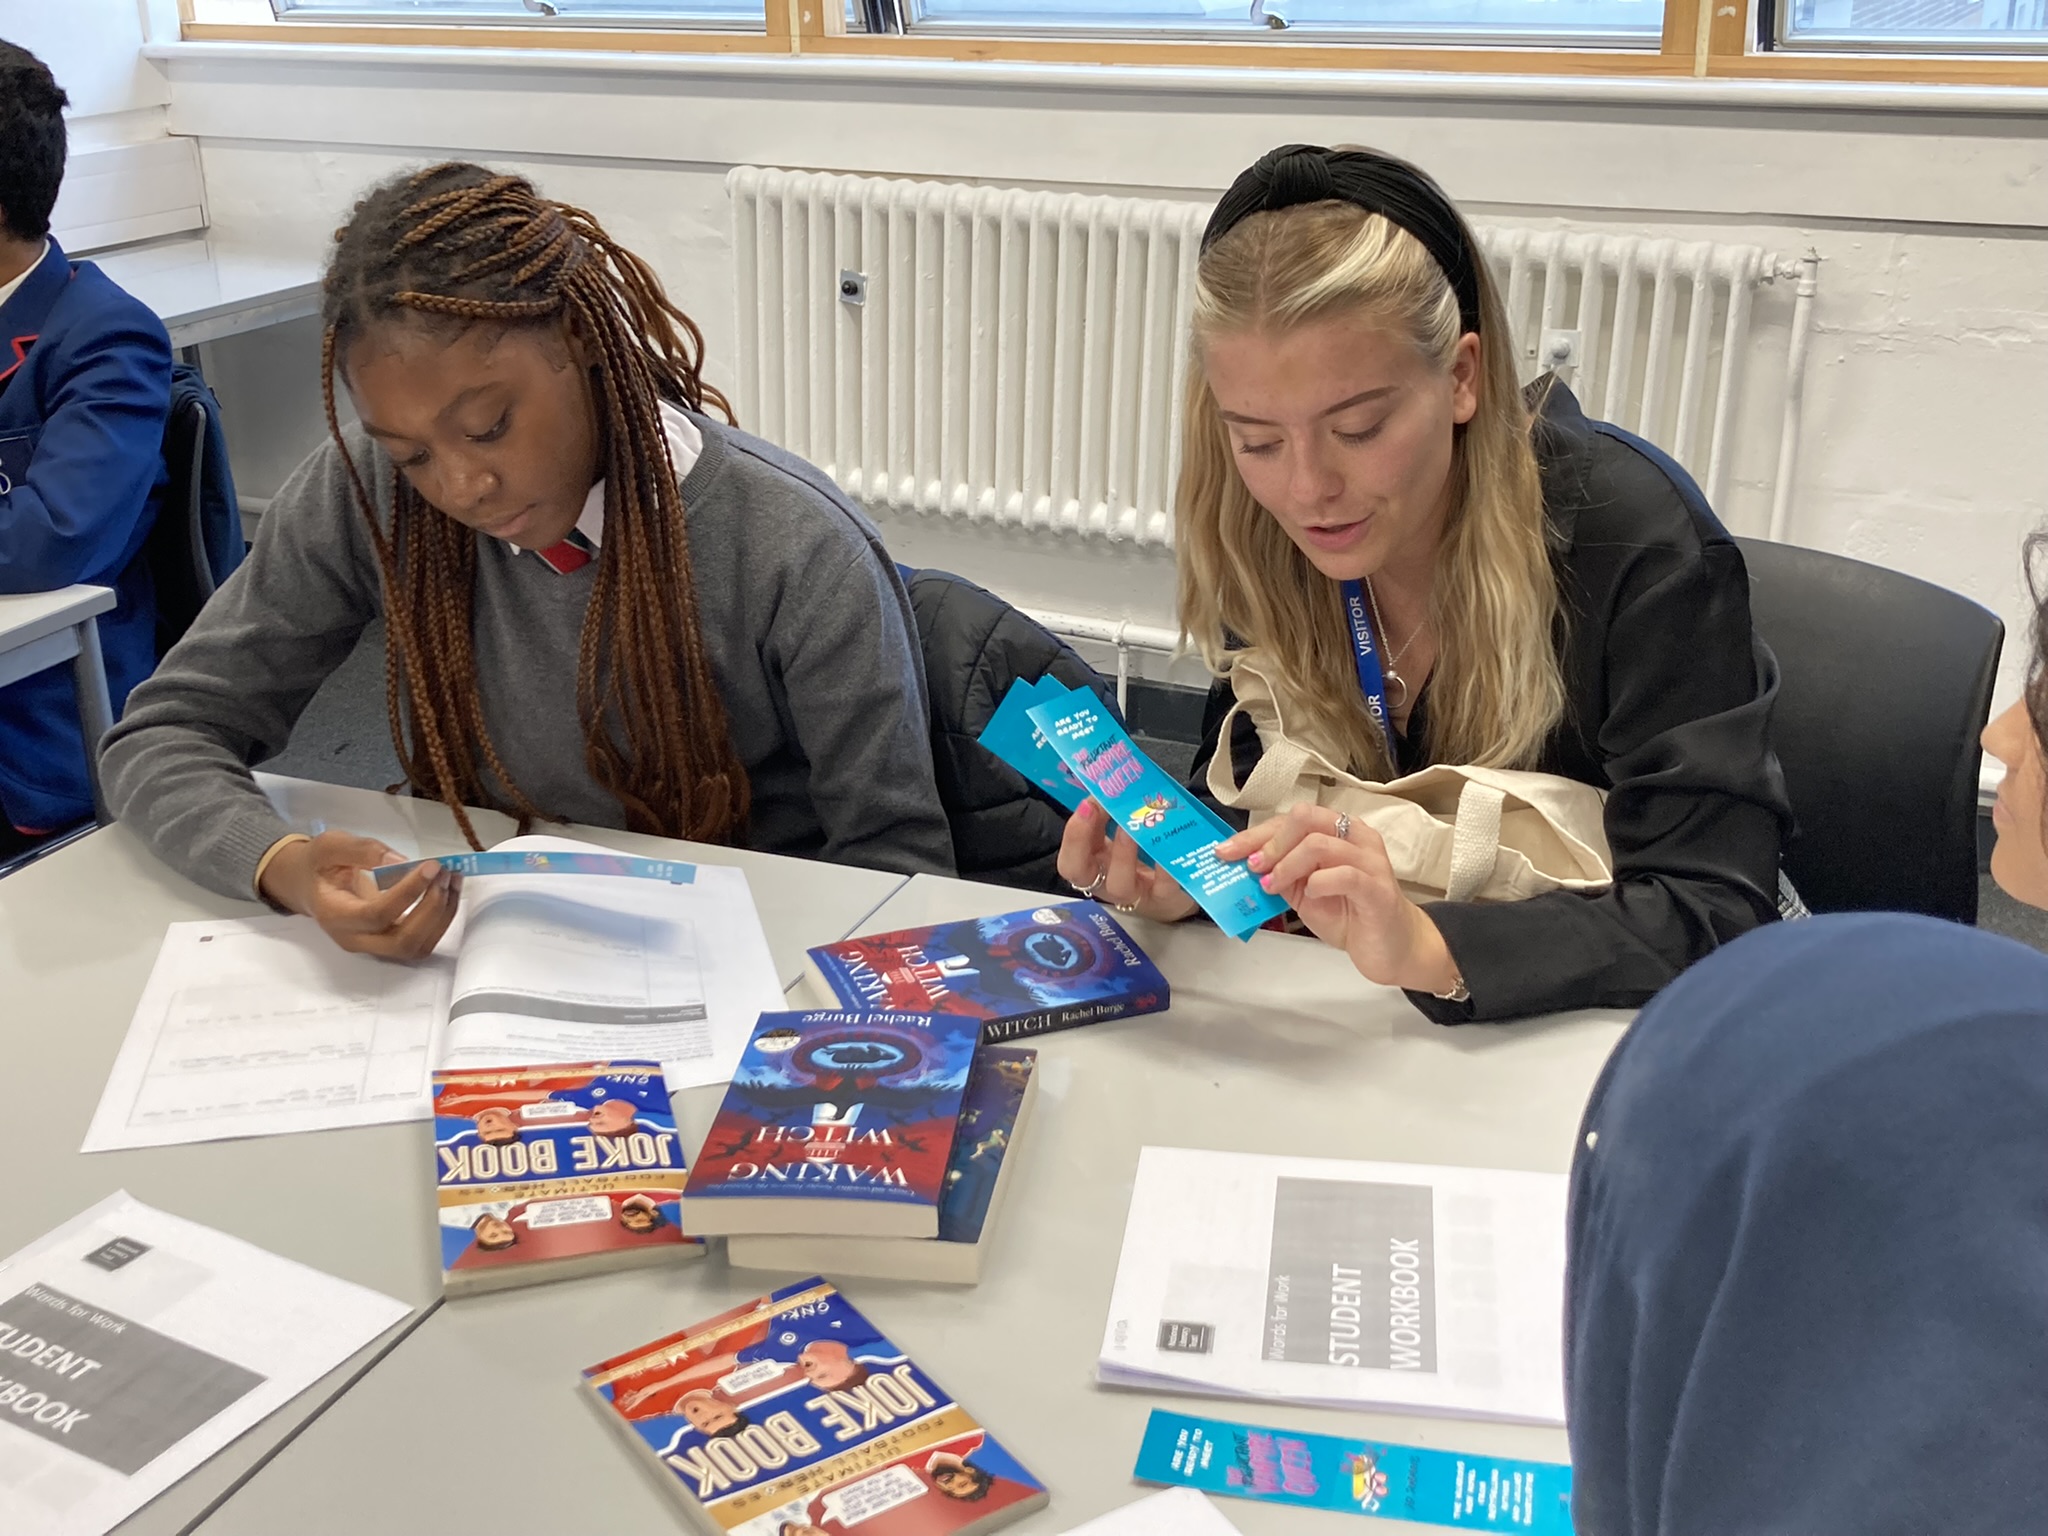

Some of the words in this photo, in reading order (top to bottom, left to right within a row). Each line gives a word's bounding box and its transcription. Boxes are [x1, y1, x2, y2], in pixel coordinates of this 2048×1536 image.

[1349, 596, 1372, 656] VISITOR
[1055, 716, 1072, 728] ARE
[1073, 708, 1090, 721] YOU
[1056, 720, 1084, 737] READY
[1076, 740, 1133, 782] VAMPIRE
[1098, 756, 1145, 798] QUEEN
[838, 950, 897, 1010] AKING
[897, 945, 950, 1000] WITCH
[801, 1012, 860, 1024] Burge
[867, 1013, 932, 1028] Rachel
[987, 1014, 1051, 1039] WITCH
[1061, 1006, 1094, 1022] Rachel
[1096, 1001, 1125, 1019] Burge
[571, 1133, 673, 1171] JOKE
[755, 1125, 894, 1146] WITCH
[438, 1139, 558, 1183] BOOK
[553, 1174, 665, 1187] FOOTBALL
[727, 1162, 909, 1187] WAKING
[514, 1183, 615, 1198] ULTIMATE
[1273, 1275, 1290, 1303] Work
[1390, 1238, 1421, 1370] WORKBOOK
[24, 1285, 68, 1310] Words
[67, 1303, 91, 1318] for
[88, 1312, 128, 1334] Work
[1271, 1304, 1288, 1320] for
[1329, 1263, 1362, 1367] STUDENT
[1269, 1323, 1287, 1360] Words
[804, 1365, 938, 1443] JOKE
[666, 1410, 822, 1498] BOOK
[831, 1417, 945, 1466] FOOTBALL
[796, 1447, 901, 1494] ULTIMATE
